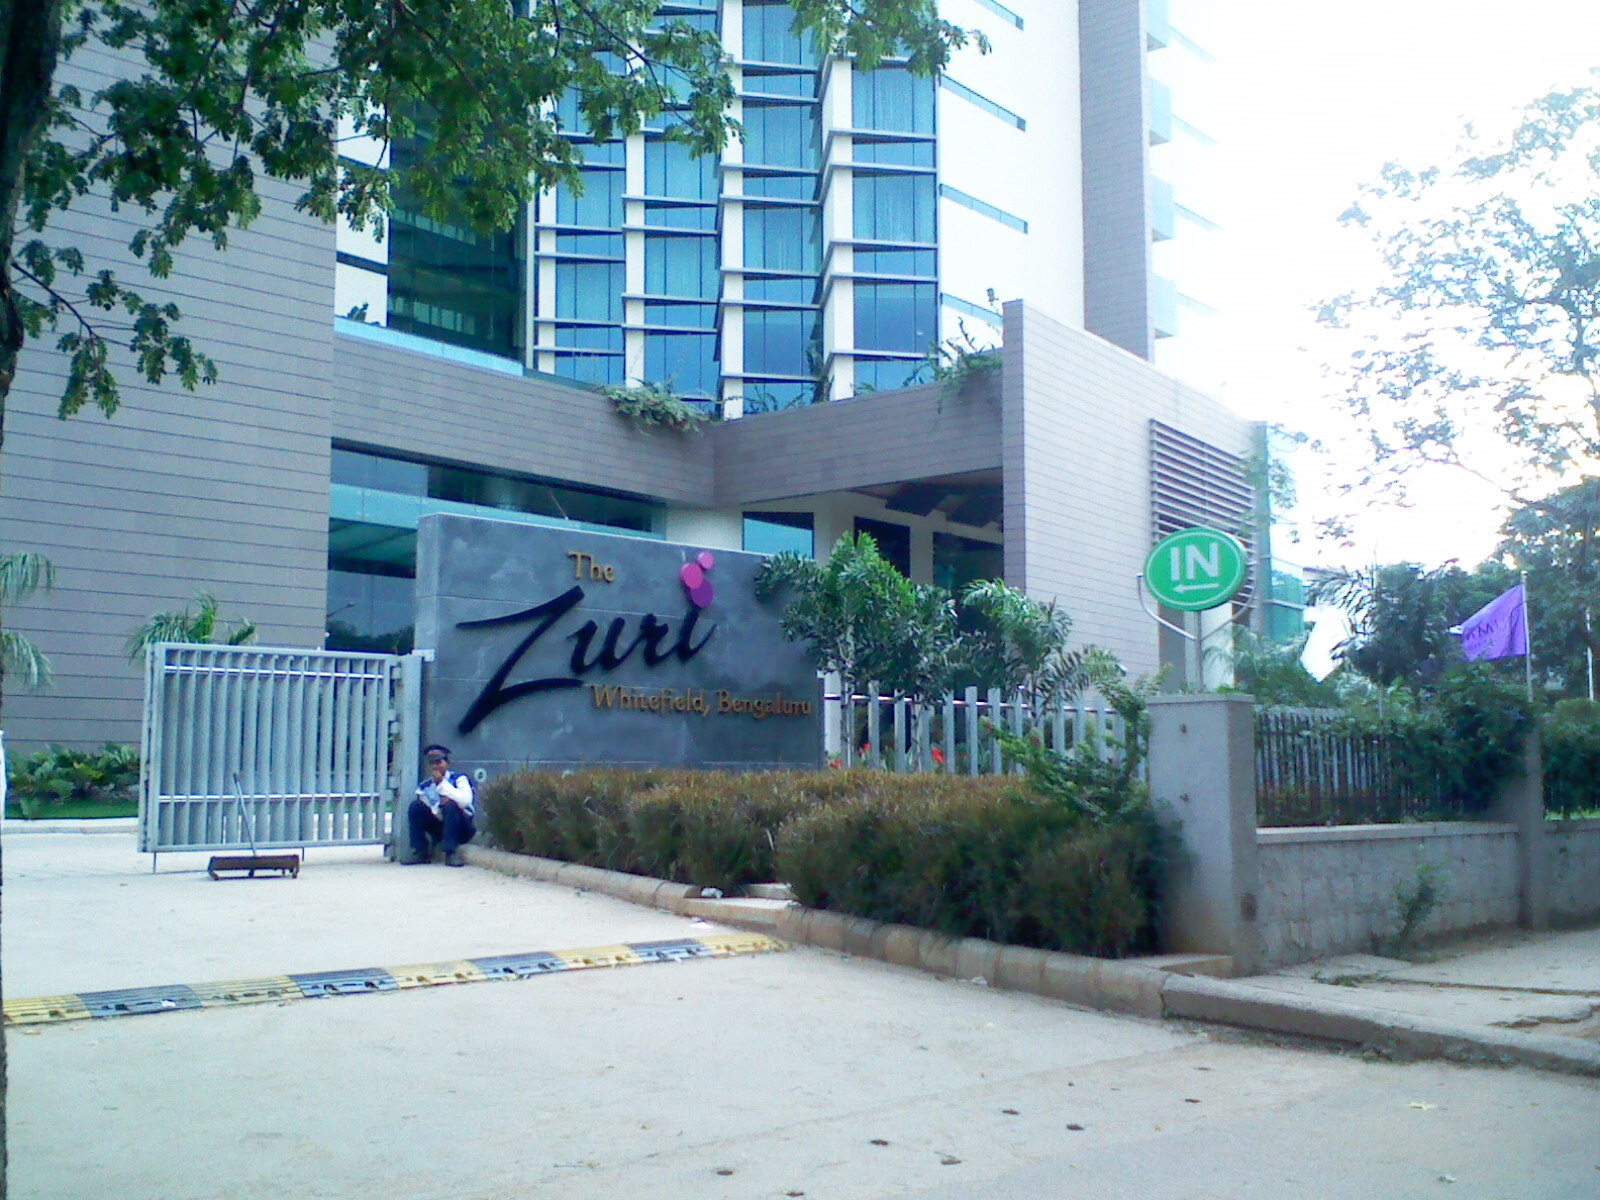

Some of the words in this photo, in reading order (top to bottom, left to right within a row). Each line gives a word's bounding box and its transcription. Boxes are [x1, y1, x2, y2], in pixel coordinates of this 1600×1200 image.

[567, 551, 615, 583] The
[1170, 542, 1219, 581] IN
[456, 552, 717, 737] Zuri
[591, 685, 710, 718] Whitefield,
[716, 690, 812, 719] Bengaluru
